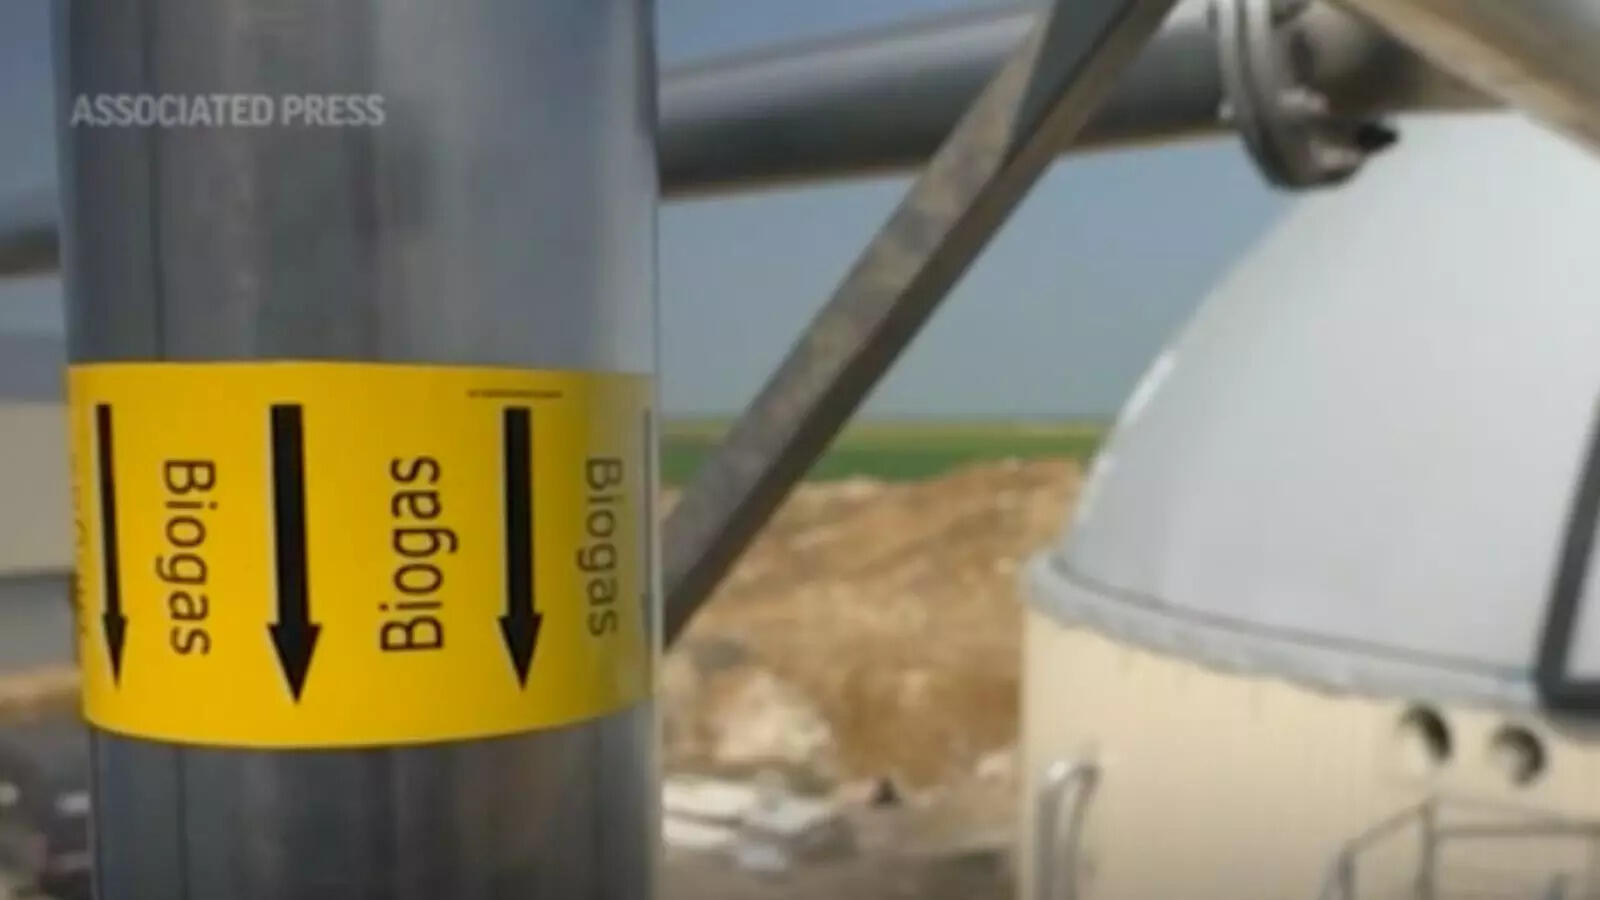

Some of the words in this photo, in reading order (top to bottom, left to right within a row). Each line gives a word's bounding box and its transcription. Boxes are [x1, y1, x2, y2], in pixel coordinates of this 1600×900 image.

[155, 459, 217, 656] Biogas
[379, 455, 459, 653] Biogas
[576, 457, 623, 637] Biogas
